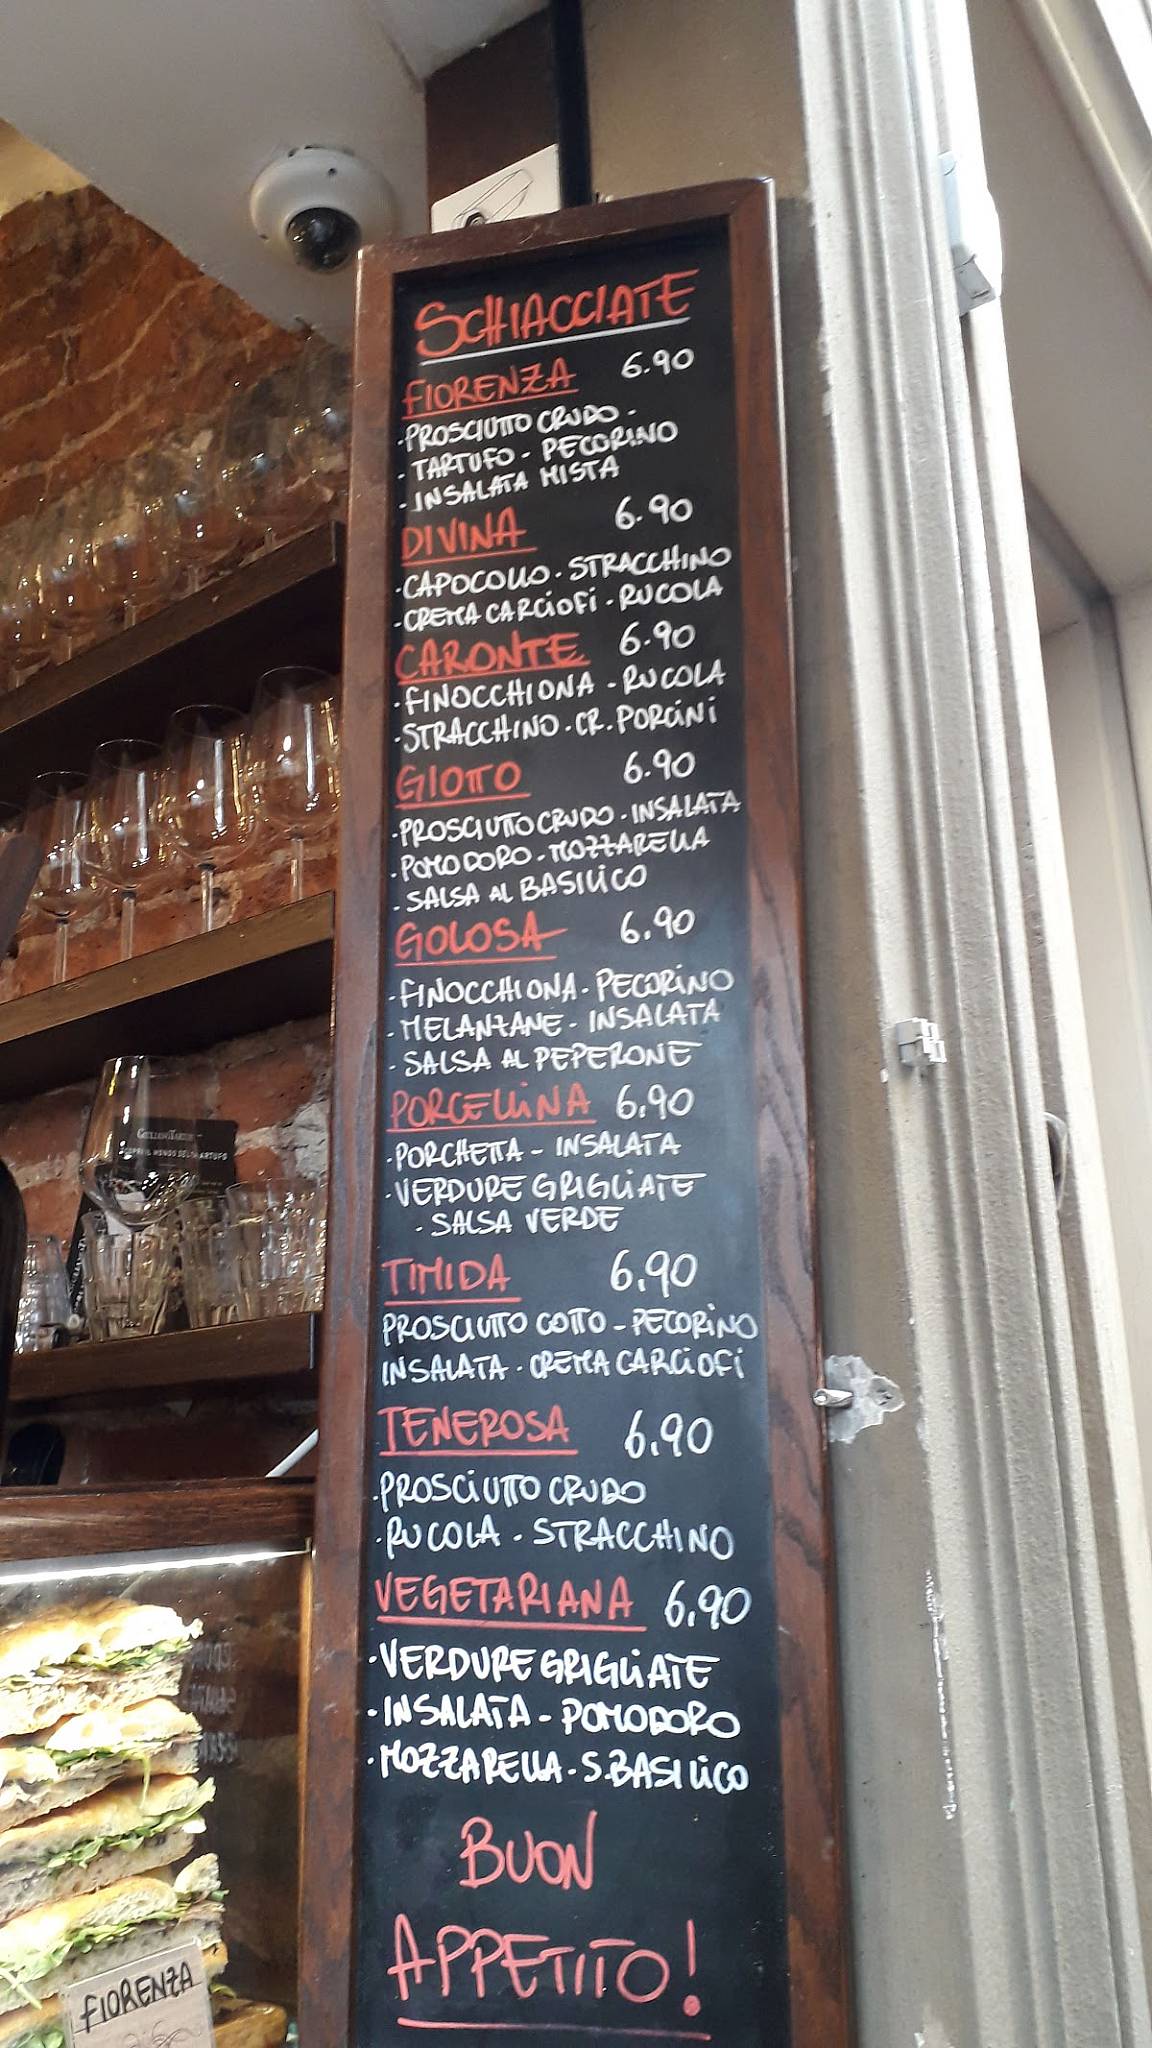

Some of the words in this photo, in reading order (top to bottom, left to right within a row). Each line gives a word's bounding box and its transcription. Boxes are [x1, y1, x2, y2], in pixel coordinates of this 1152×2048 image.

[414, 269, 700, 357] SCHIACCIATE
[620, 348, 695, 378] 6.90
[402, 357, 577, 416] FIORENZA
[405, 413, 533, 453] PROSCIUTTO
[536, 404, 619, 434] CRUDO
[411, 448, 516, 482] TARTUFO
[541, 420, 680, 462] PECORINO
[411, 470, 529, 512] INSALATA
[540, 454, 621, 487] MISTA
[402, 506, 527, 561] DIVINA
[614, 493, 694, 531] 6.90
[403, 565, 551, 600] CAPOCOLLO
[568, 544, 732, 582] STRACCHINO
[404, 606, 482, 633] CREMA
[619, 575, 723, 611] RUCOLA
[395, 630, 585, 681] CARONTE
[619, 620, 696, 656] 6.90
[405, 670, 595, 715] FINOCCHIONA
[623, 658, 726, 696] RUCOLA
[403, 713, 560, 753] STRACCHINO
[395, 760, 523, 802] GIOTTO
[623, 748, 696, 784] 6.90
[399, 812, 535, 848] PROSCIUTTO
[536, 805, 615, 836] CRUDO
[631, 789, 742, 824] INSALATA
[400, 845, 533, 882] POMODORO
[548, 826, 710, 863] MOZZARELLA
[405, 883, 480, 913] SALSA
[489, 883, 513, 904] AL
[394, 910, 569, 962] GOLOSA
[620, 905, 696, 945] 6.90
[400, 971, 578, 1009] FINOCCHIONA
[400, 1010, 564, 1042] MELANZANE
[588, 997, 721, 1033] INSALATA
[403, 1047, 492, 1077] SALSA
[501, 1047, 529, 1069] AL
[534, 1040, 703, 1072] PEPERONE
[615, 1083, 695, 1121] 6.90
[395, 1137, 524, 1172] PORCHETTA
[555, 1131, 682, 1159] INSALATA
[394, 1174, 527, 1207] VERDURE
[431, 1209, 513, 1237] SALSA
[525, 1205, 625, 1234] VERDE
[382, 1253, 511, 1296] TIMIDA
[610, 1250, 698, 1298] 6.90
[382, 1312, 528, 1347] PROSCIUTTO
[535, 1307, 607, 1336] COTTO
[382, 1354, 509, 1385] INSALATA
[529, 1349, 610, 1379] CREMA
[378, 1404, 569, 1452] TENEROSA
[623, 1409, 713, 1459] 6.90
[549, 1475, 647, 1506] CRUDO
[386, 1514, 501, 1559] RUCOLA
[533, 1517, 735, 1561] STRACCHINO
[375, 1571, 633, 1621] VEGETARIANA
[663, 1580, 752, 1630] 6.90
[380, 1638, 536, 1682] VERDURE
[384, 1693, 531, 1730] INSALATA
[562, 1697, 741, 1739] POMODORO
[380, 1739, 562, 1785] MOZZARELLA
[459, 1809, 598, 1890] BUON
[79, 1961, 193, 2034] FIORENZA
